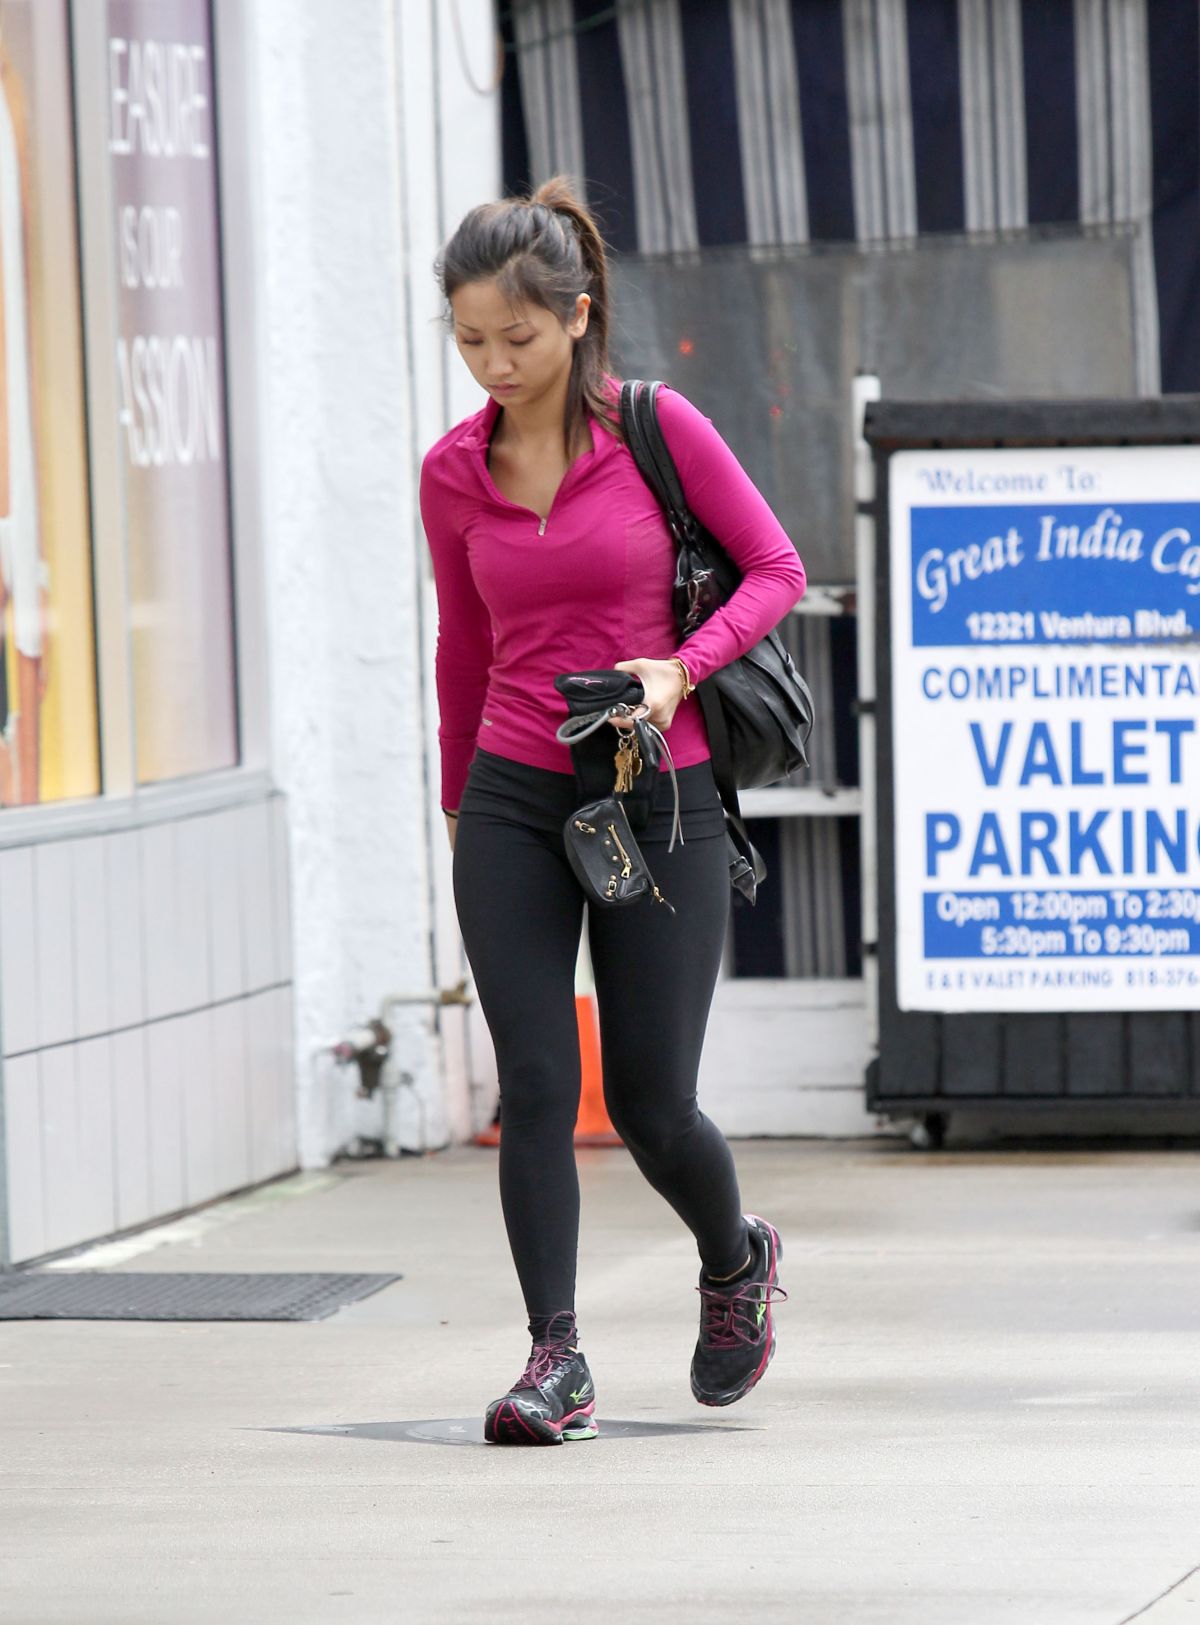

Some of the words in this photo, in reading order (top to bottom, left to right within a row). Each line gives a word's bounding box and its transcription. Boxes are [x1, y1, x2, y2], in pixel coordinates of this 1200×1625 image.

[916, 467, 1048, 493] Welcome
[916, 526, 1025, 613] Great
[1036, 507, 1144, 563] India
[1150, 527, 1200, 596] Ca
[966, 610, 1035, 640] 12321
[1039, 611, 1132, 640] Ventura
[1134, 607, 1193, 638] Blvd.
[968, 719, 1195, 787] VALET
[924, 808, 1200, 878] PARKIN
[936, 891, 1000, 927] Open
[1010, 890, 1108, 924] 12:00pm
[1110, 889, 1144, 919] To
[980, 925, 1067, 958] 5:30pm
[1069, 924, 1103, 954] To
[1103, 923, 1191, 958] 9:30pm
[971, 969, 1025, 990] VALET
[1031, 967, 1113, 989] PARKING
